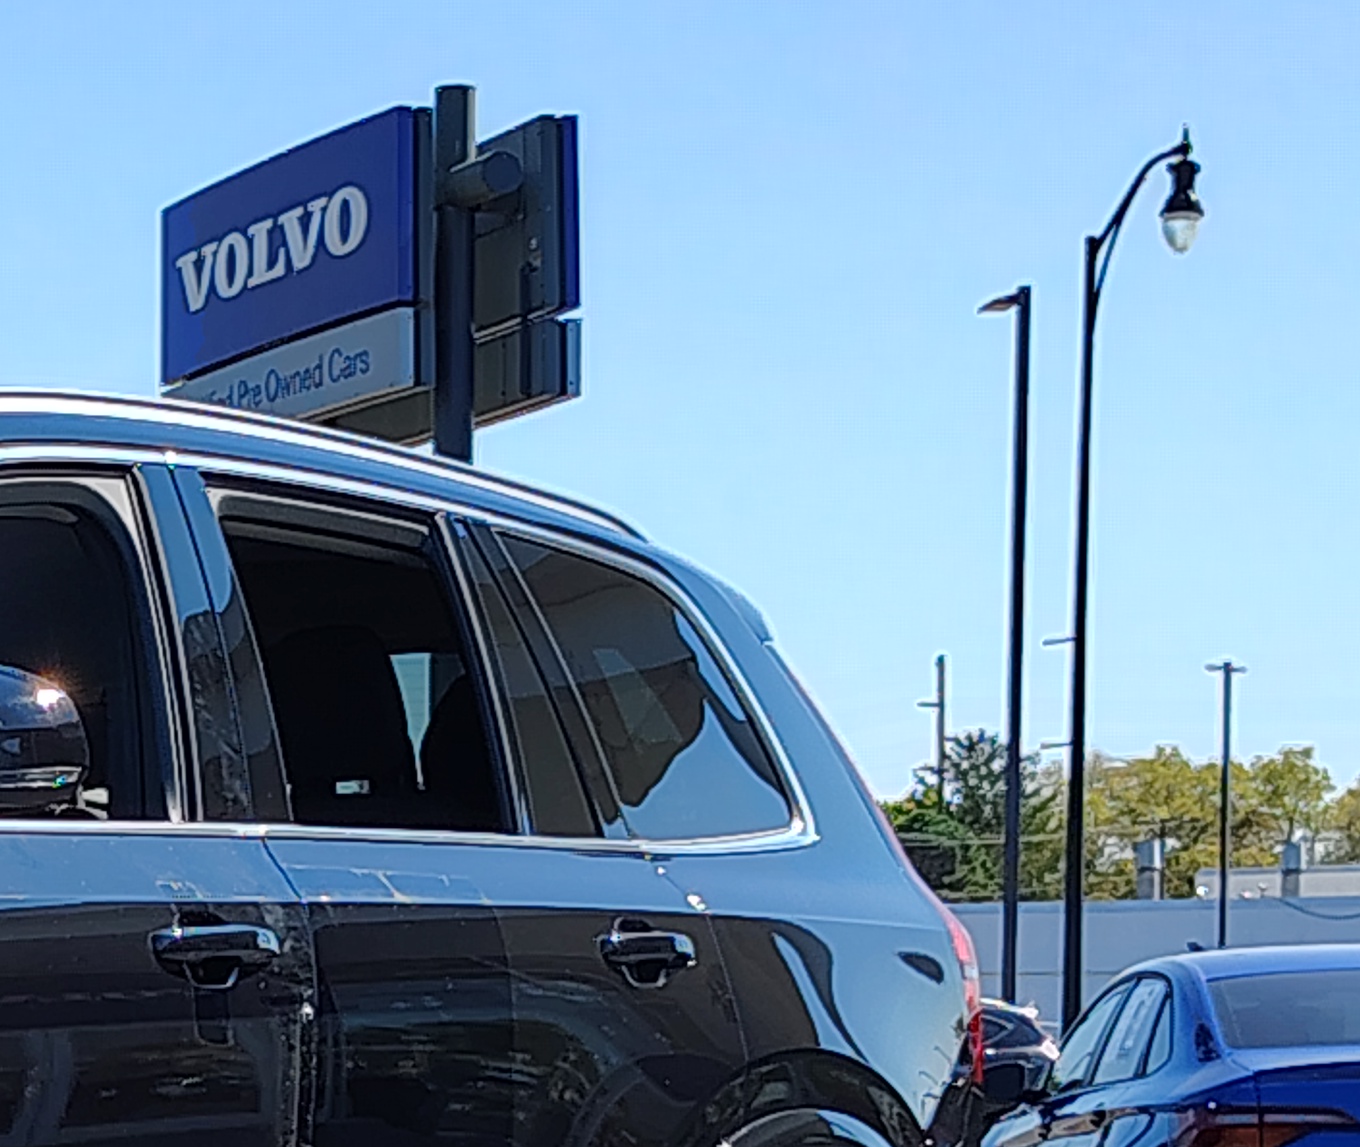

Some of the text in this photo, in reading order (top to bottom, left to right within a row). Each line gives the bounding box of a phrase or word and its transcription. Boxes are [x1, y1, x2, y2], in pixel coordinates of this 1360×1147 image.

[176, 186, 368, 312] VOLVO
[265, 353, 324, 403] Owned
[328, 348, 370, 384] Cars
